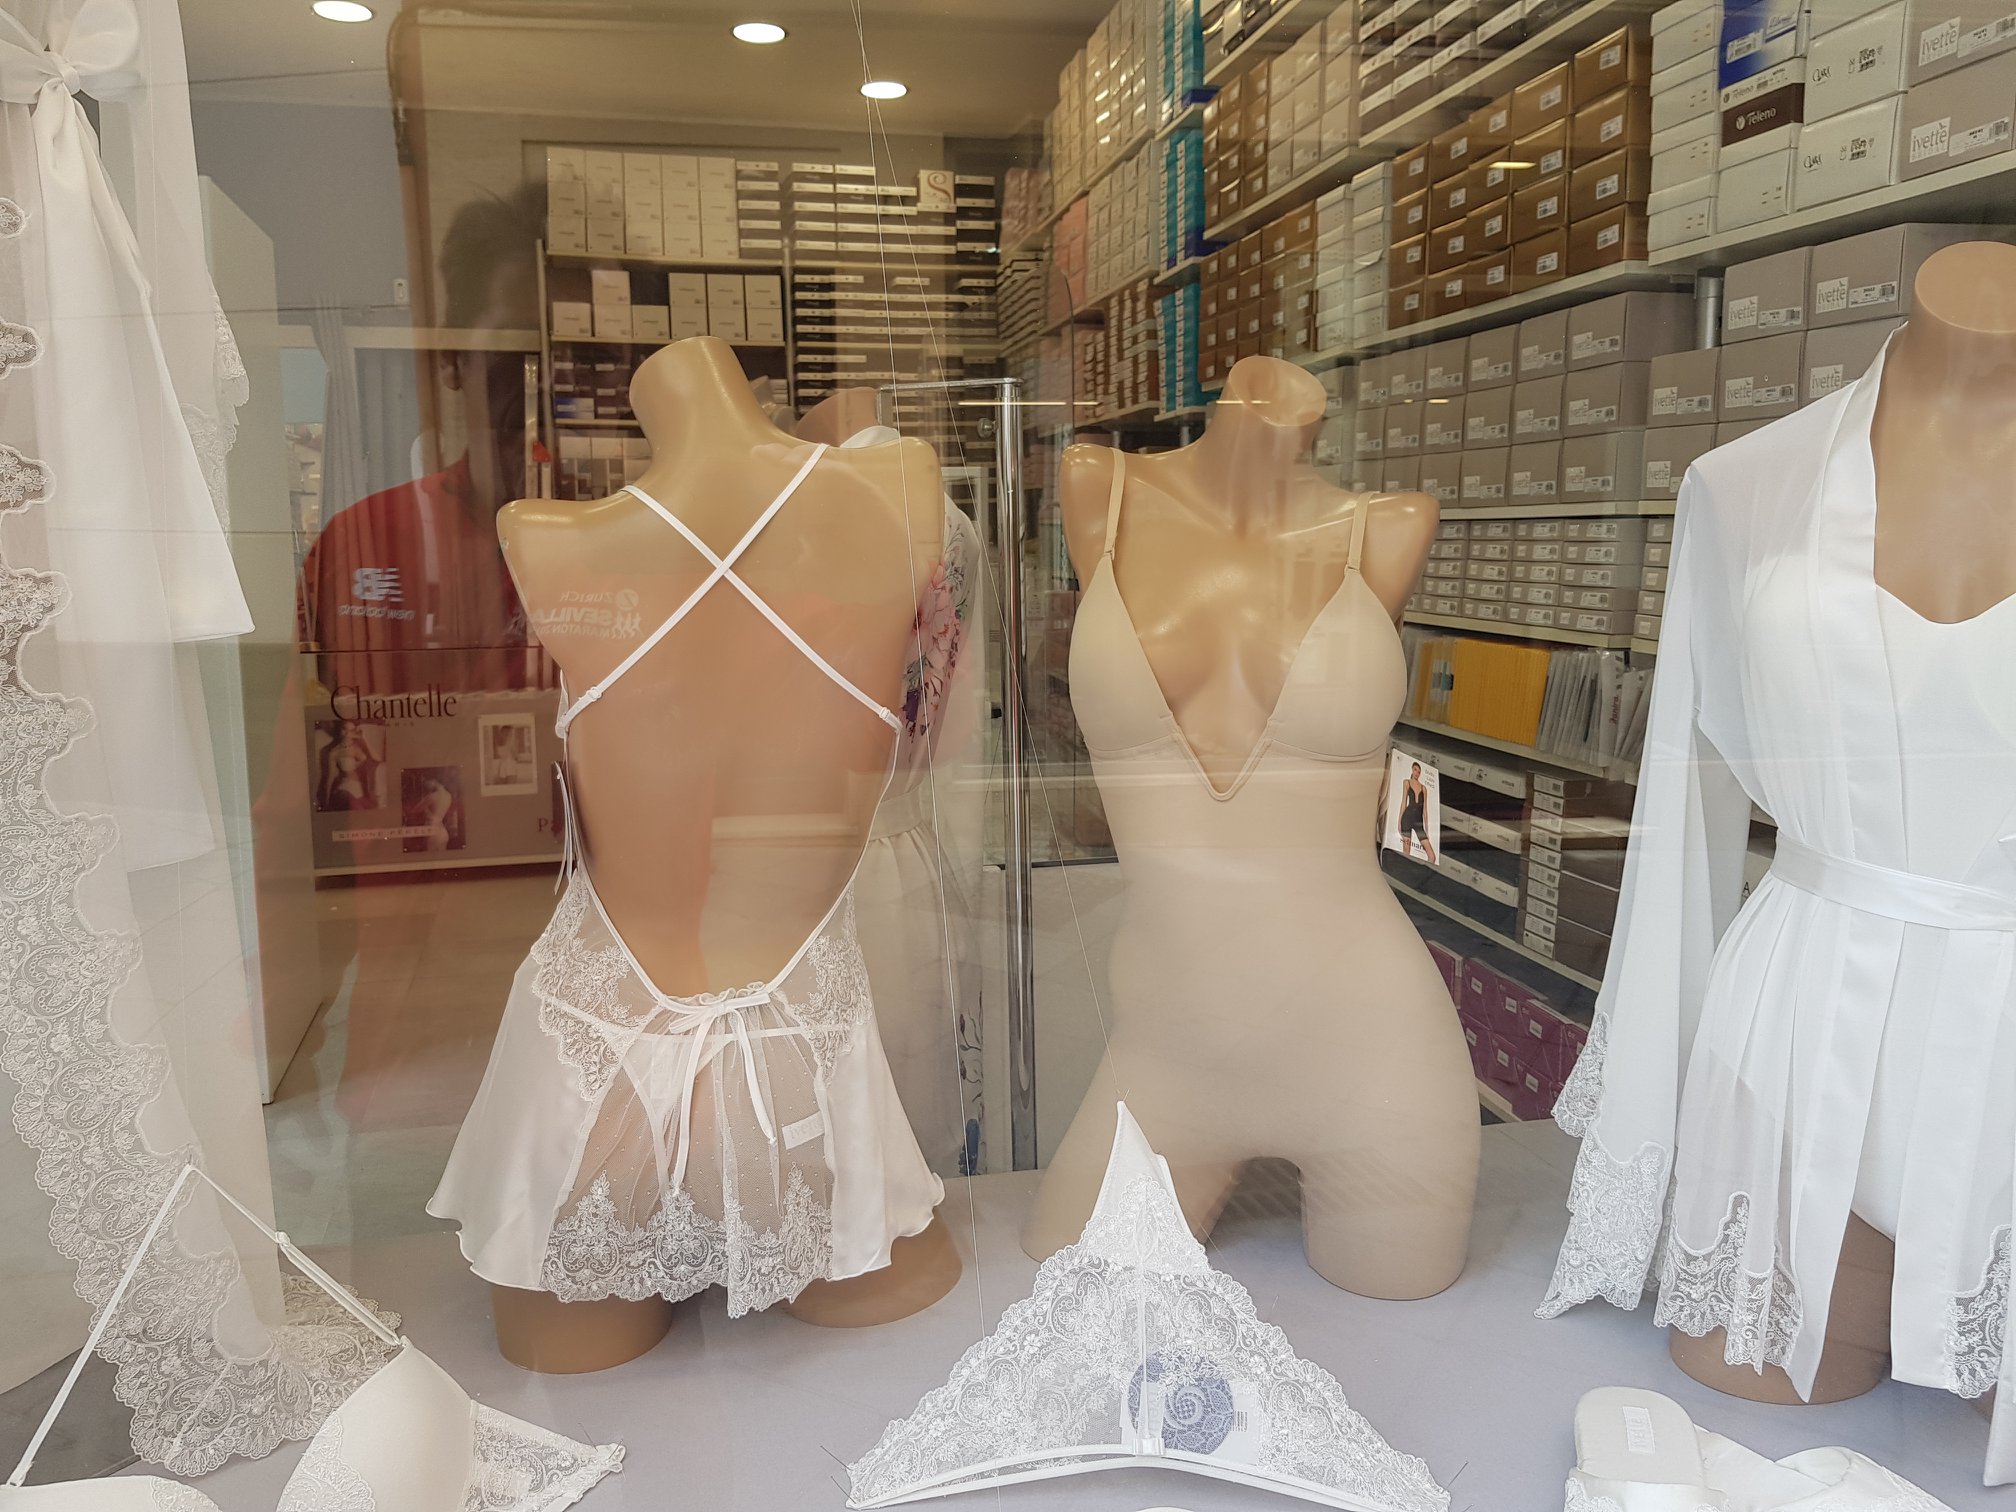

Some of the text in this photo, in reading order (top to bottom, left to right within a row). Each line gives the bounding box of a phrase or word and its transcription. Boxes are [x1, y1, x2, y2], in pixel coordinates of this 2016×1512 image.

[1746, 107, 1777, 126] Teleno
[1912, 128, 1947, 152] ivette
[330, 684, 457, 721] Chantelle
